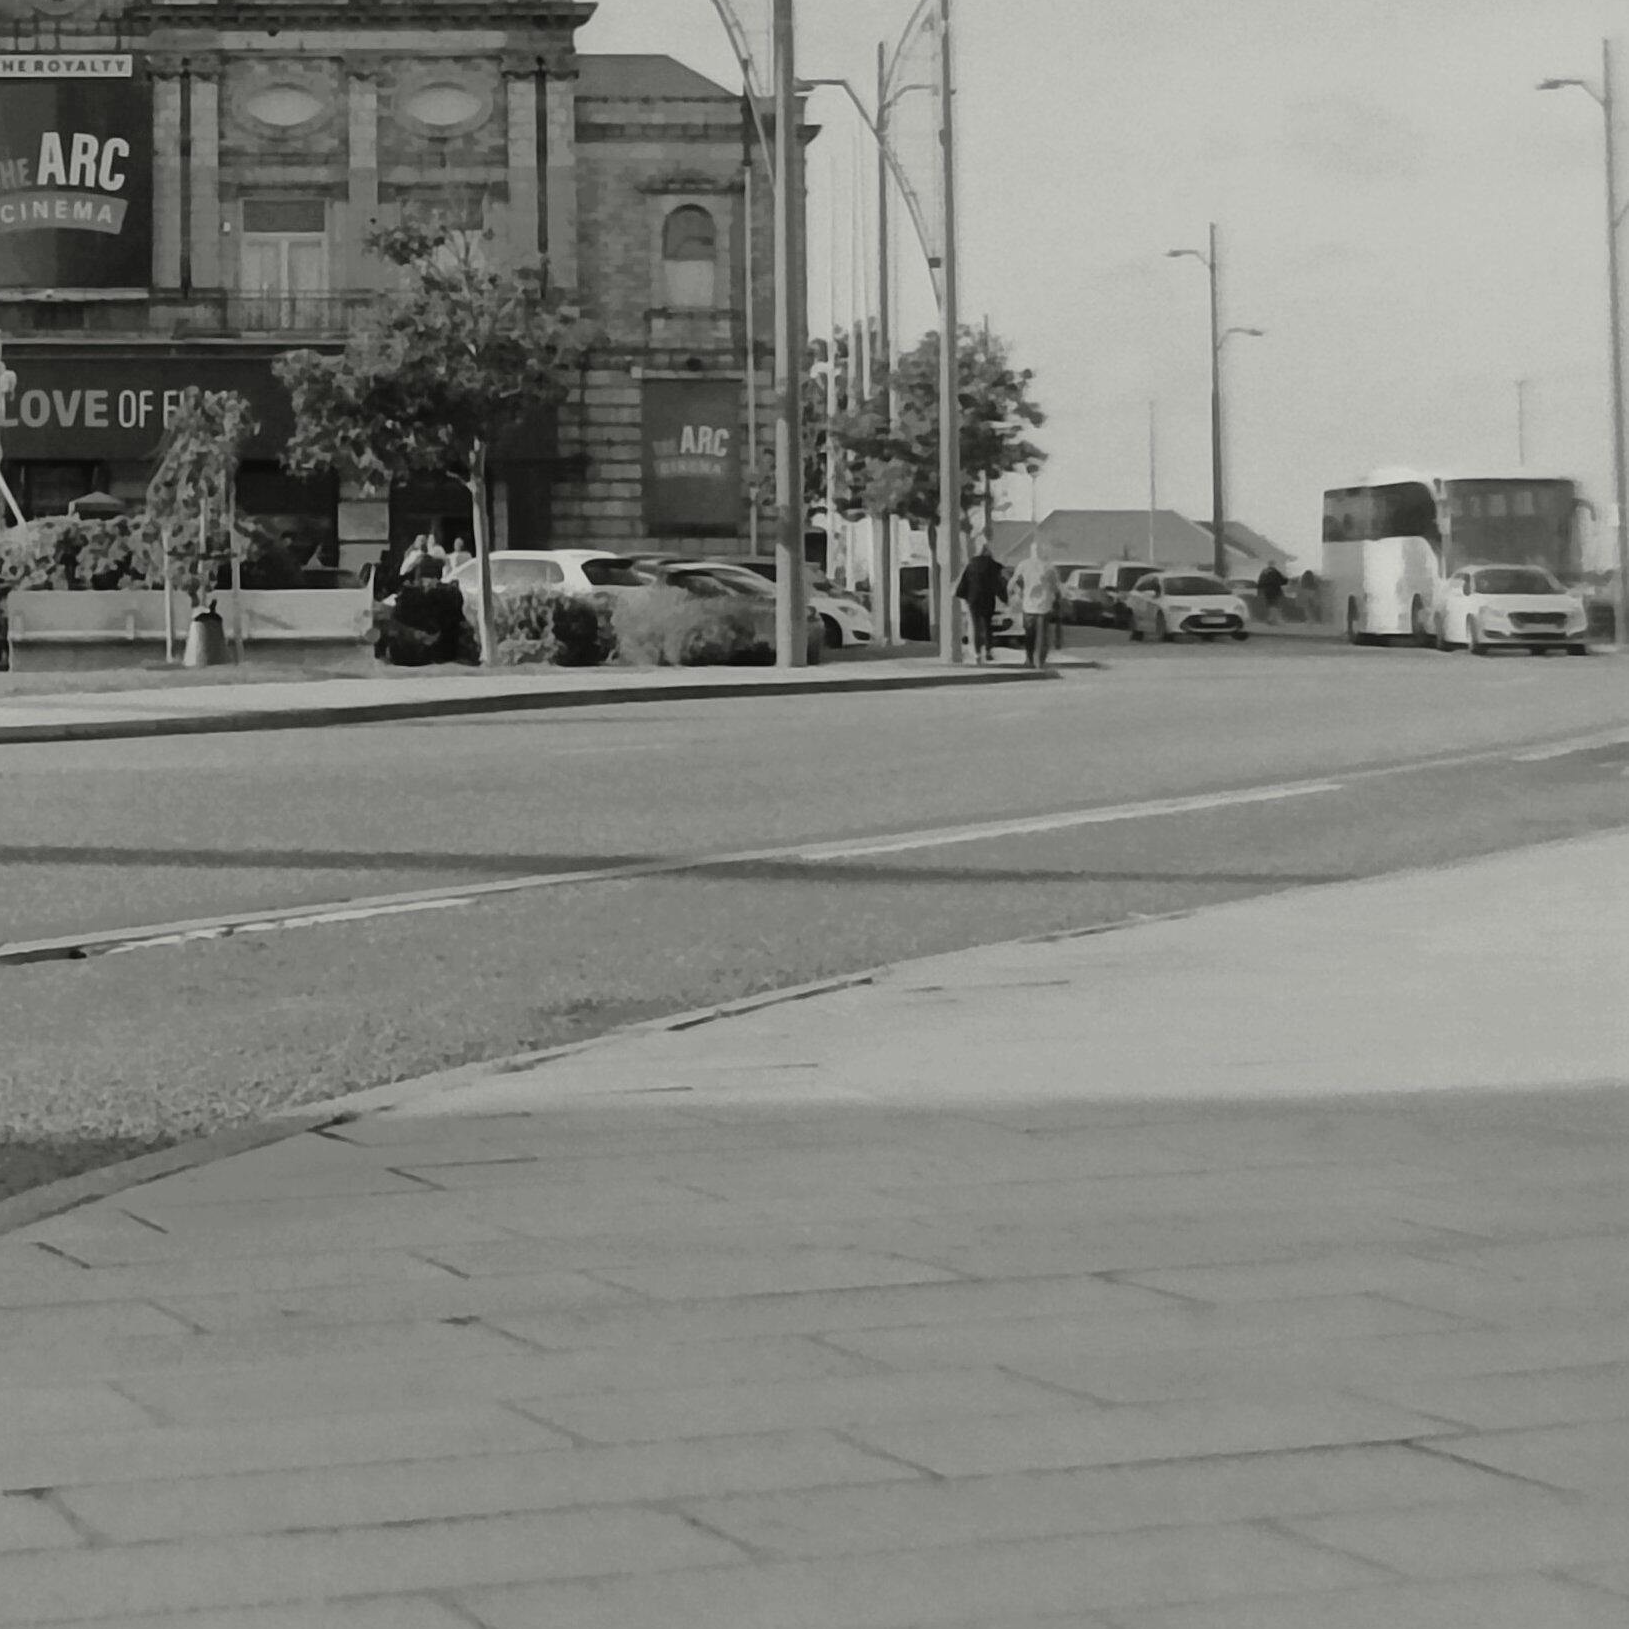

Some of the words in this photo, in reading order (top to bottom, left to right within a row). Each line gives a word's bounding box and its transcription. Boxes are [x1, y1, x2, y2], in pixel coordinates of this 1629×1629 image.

[33, 59, 125, 72] ROYALTY
[37, 131, 130, 191] ARC
[0, 200, 112, 223] CINEMA
[118, 389, 154, 428] OF
[680, 424, 730, 457] ARC
